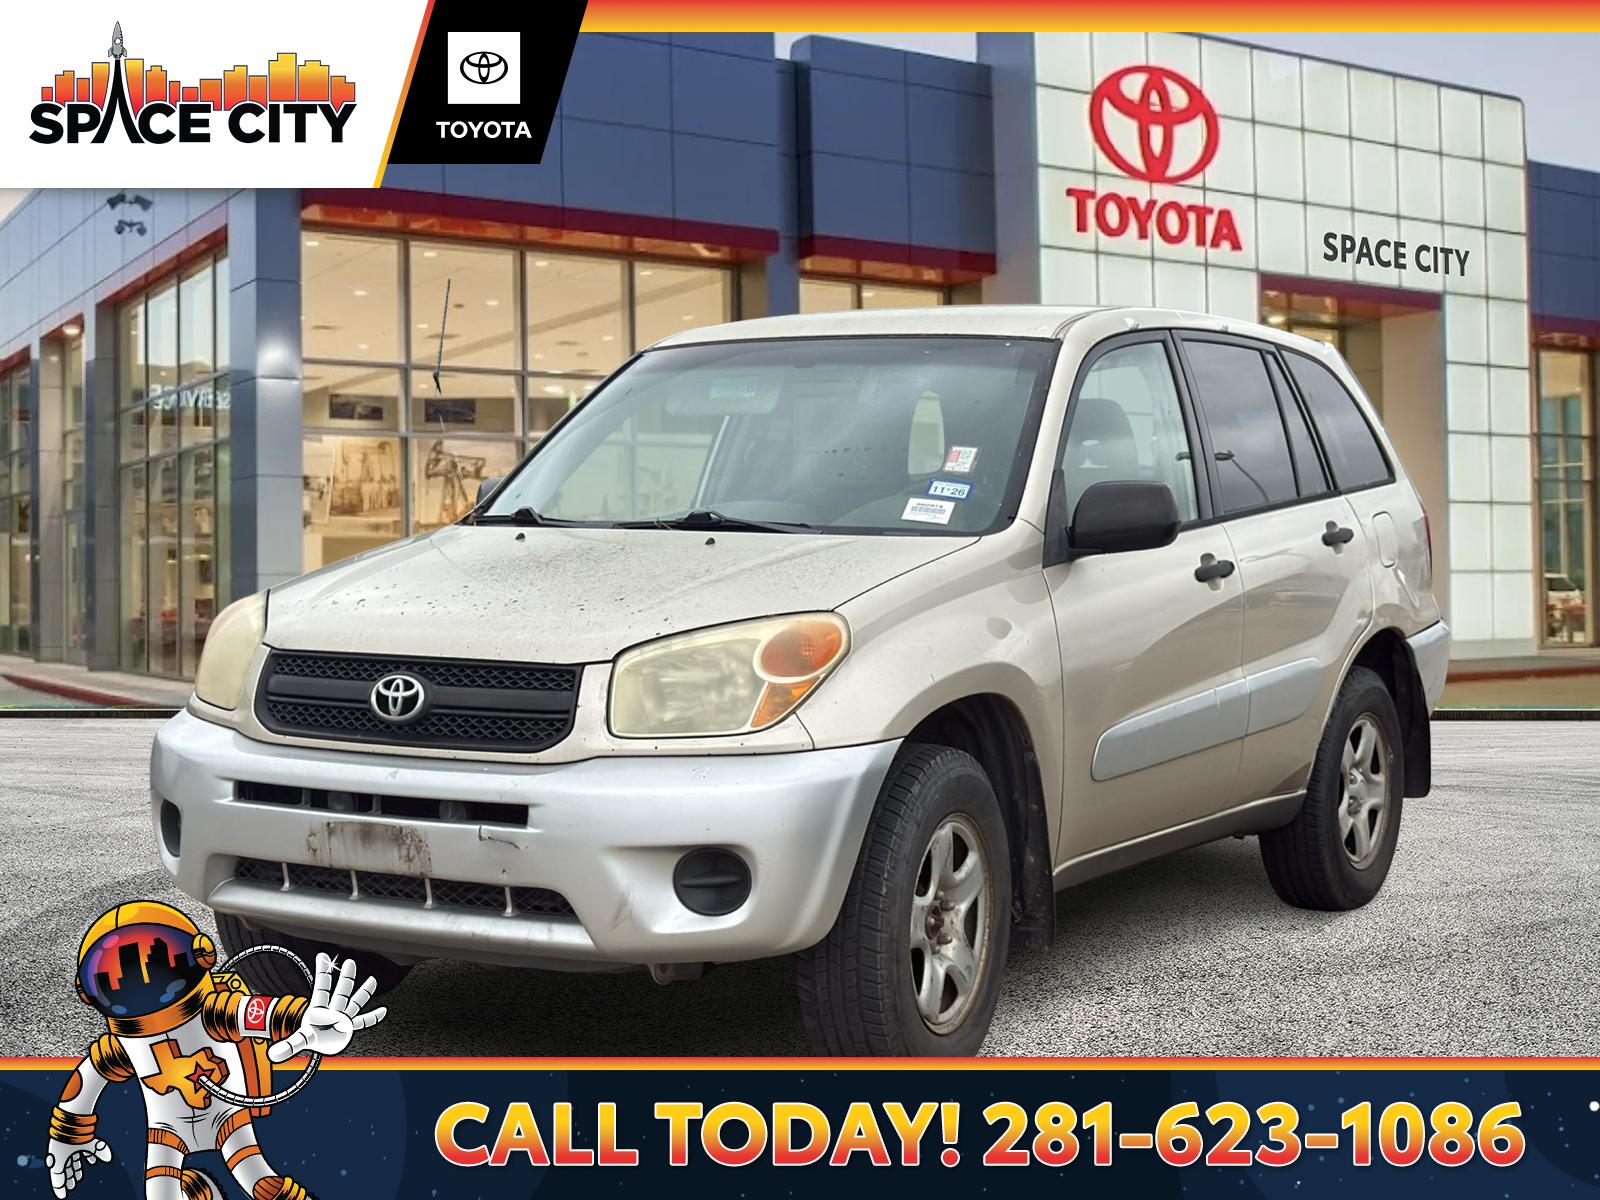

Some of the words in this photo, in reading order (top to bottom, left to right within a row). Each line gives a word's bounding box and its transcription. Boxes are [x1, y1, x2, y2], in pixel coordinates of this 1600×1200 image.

[1065, 188, 1242, 251] TOYOTA
[1323, 232, 1407, 270] SPACE
[1415, 244, 1470, 277] CITY
